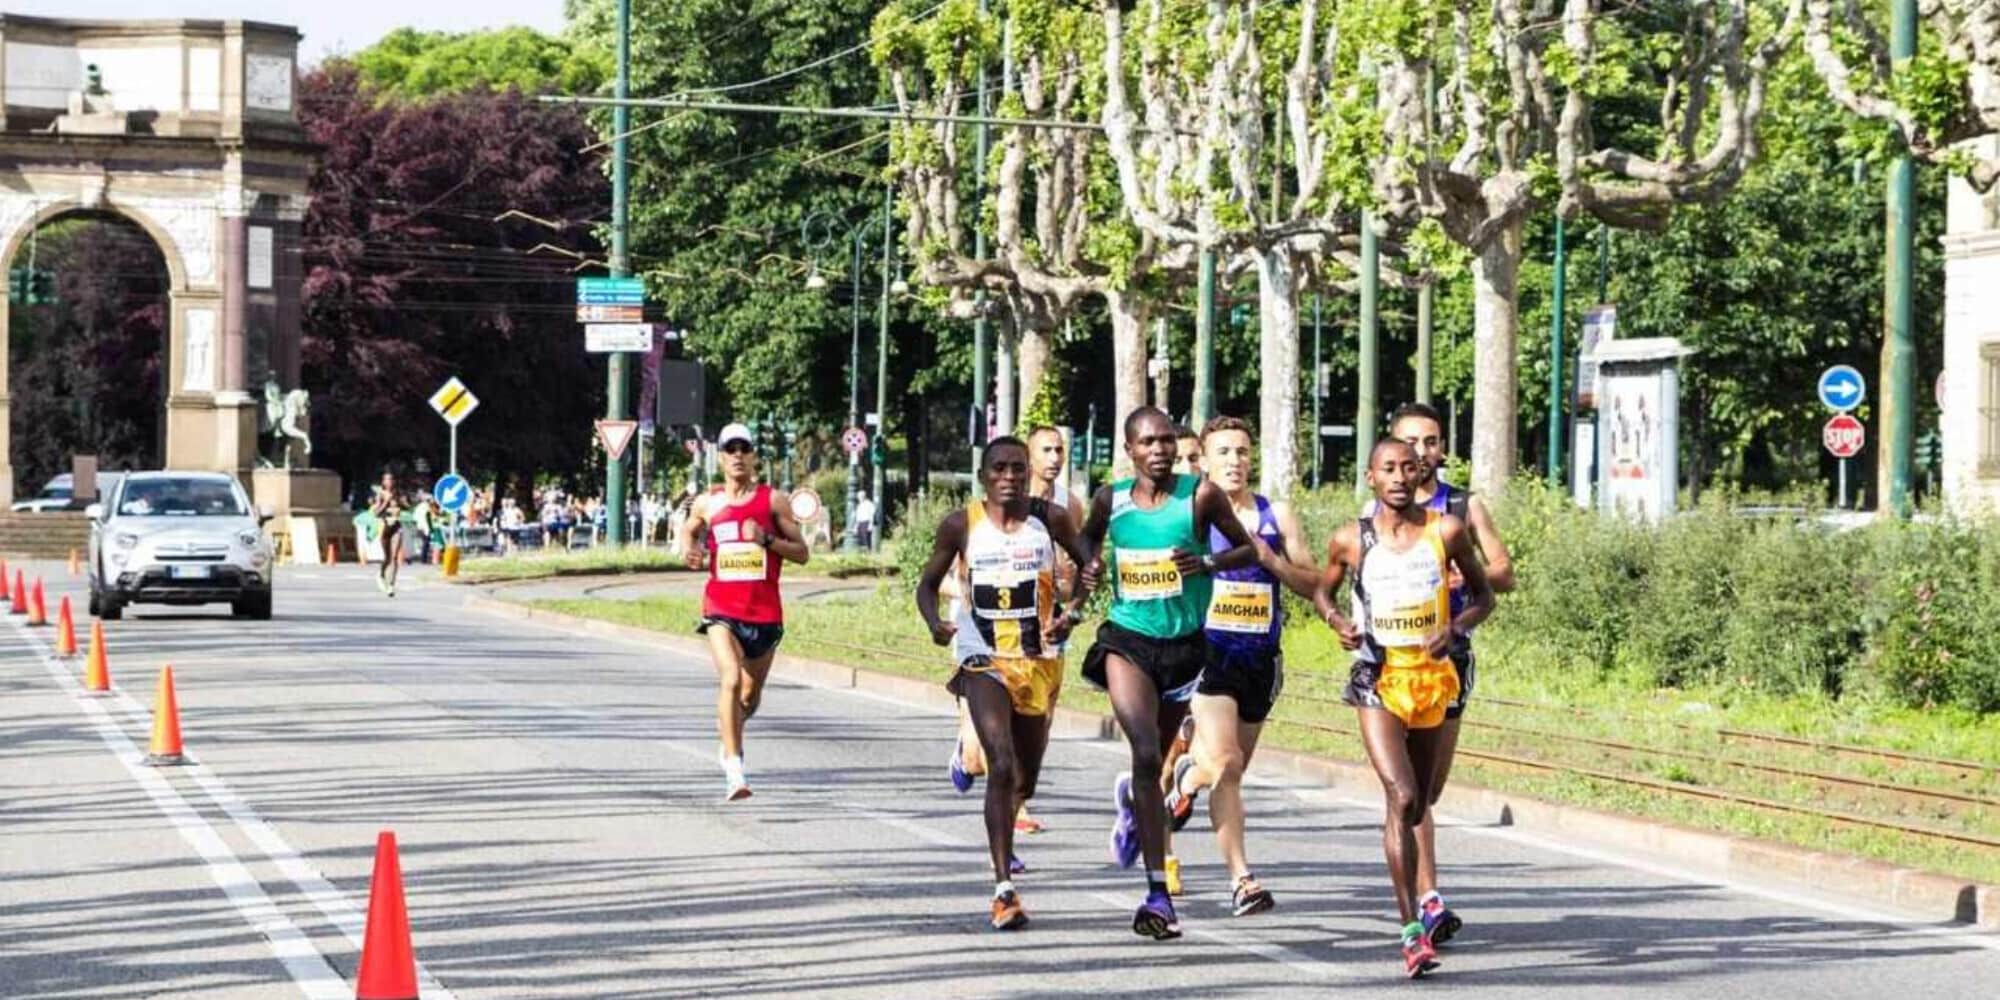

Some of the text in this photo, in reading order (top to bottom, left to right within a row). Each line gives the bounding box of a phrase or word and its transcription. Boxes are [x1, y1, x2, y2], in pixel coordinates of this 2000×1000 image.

[1826, 428, 1862, 450] STOP
[1121, 570, 1178, 585] KISORIO
[997, 587, 1011, 609] 3
[1212, 603, 1269, 618] AMGHAR
[1374, 612, 1437, 630] MUTHONI
